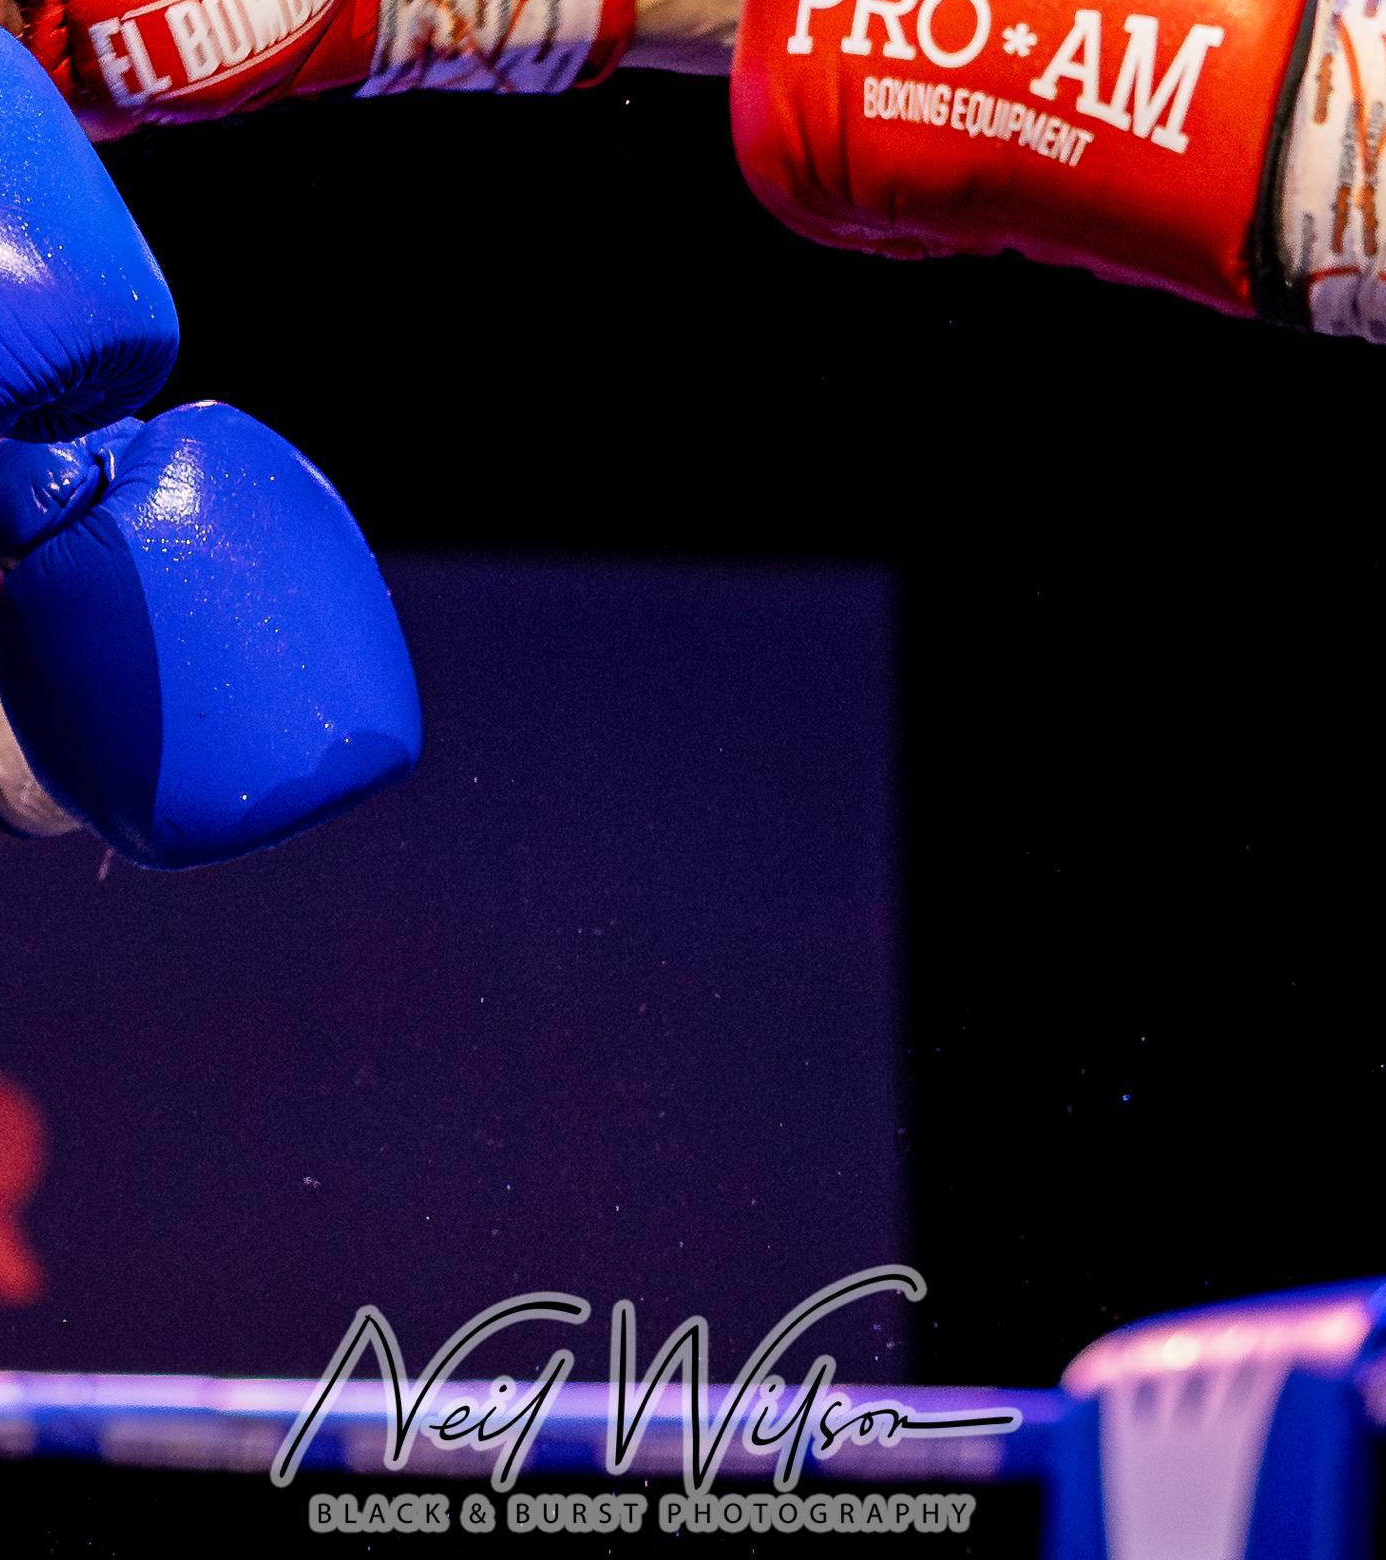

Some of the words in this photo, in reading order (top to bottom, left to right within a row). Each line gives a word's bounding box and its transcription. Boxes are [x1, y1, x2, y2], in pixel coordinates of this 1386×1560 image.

[89, 16, 174, 109] EL
[862, 75, 948, 126] BOXING
[950, 90, 1095, 168] EQUIPMENT
